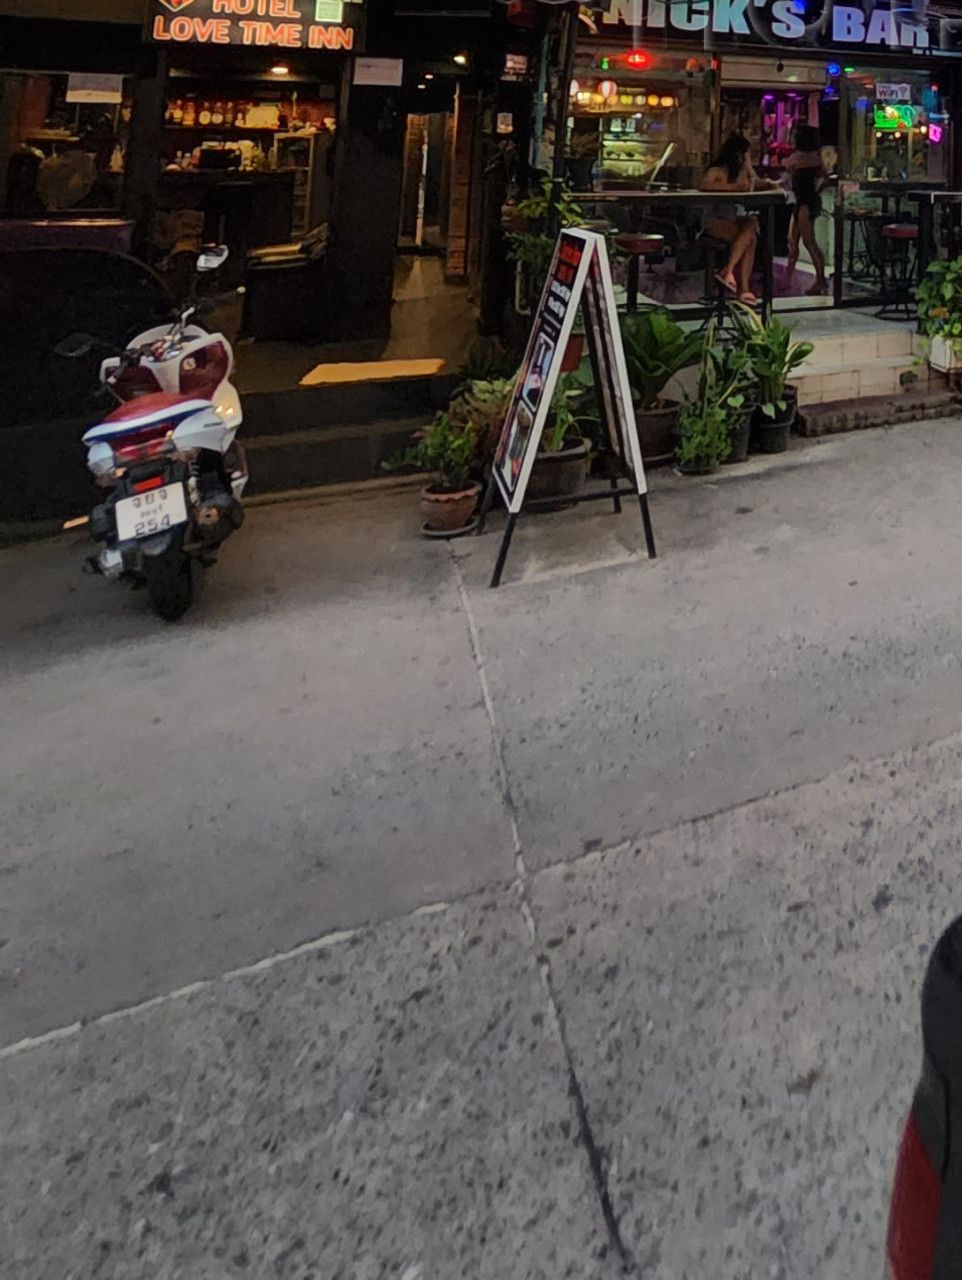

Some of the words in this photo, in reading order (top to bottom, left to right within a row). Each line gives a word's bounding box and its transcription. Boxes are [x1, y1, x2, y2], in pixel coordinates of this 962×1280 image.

[153, 15, 230, 44] LOVE
[239, 20, 302, 47] TIME
[308, 26, 353, 50] INN
